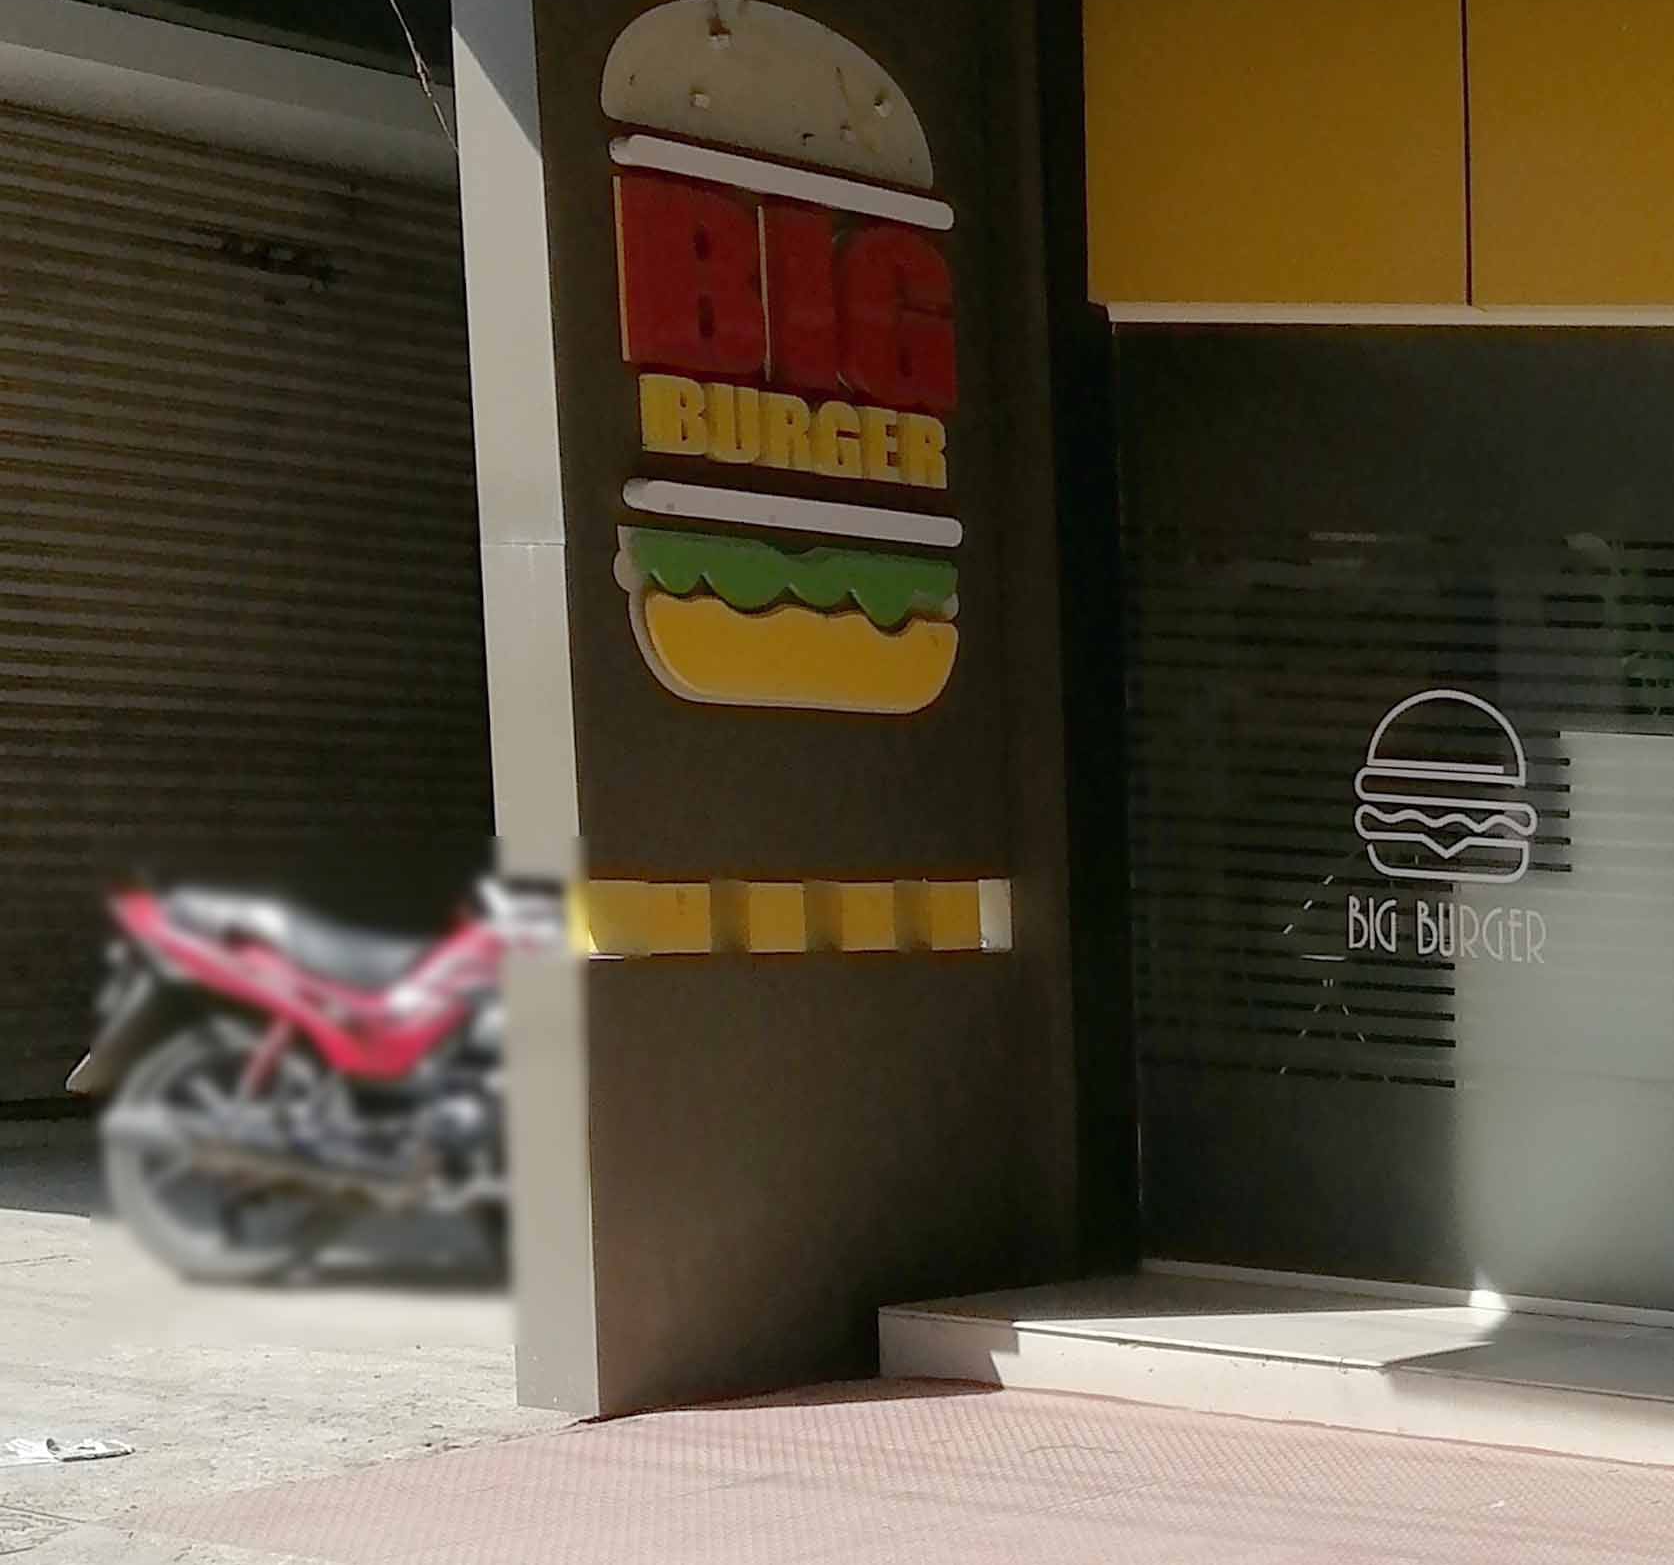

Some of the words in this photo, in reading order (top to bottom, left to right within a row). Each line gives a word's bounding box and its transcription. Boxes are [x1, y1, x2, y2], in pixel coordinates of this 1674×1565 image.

[612, 175, 958, 409] BIG
[639, 373, 947, 490] BURGER
[1348, 895, 1396, 953] BIG
[1416, 899, 1547, 964] BURGER
